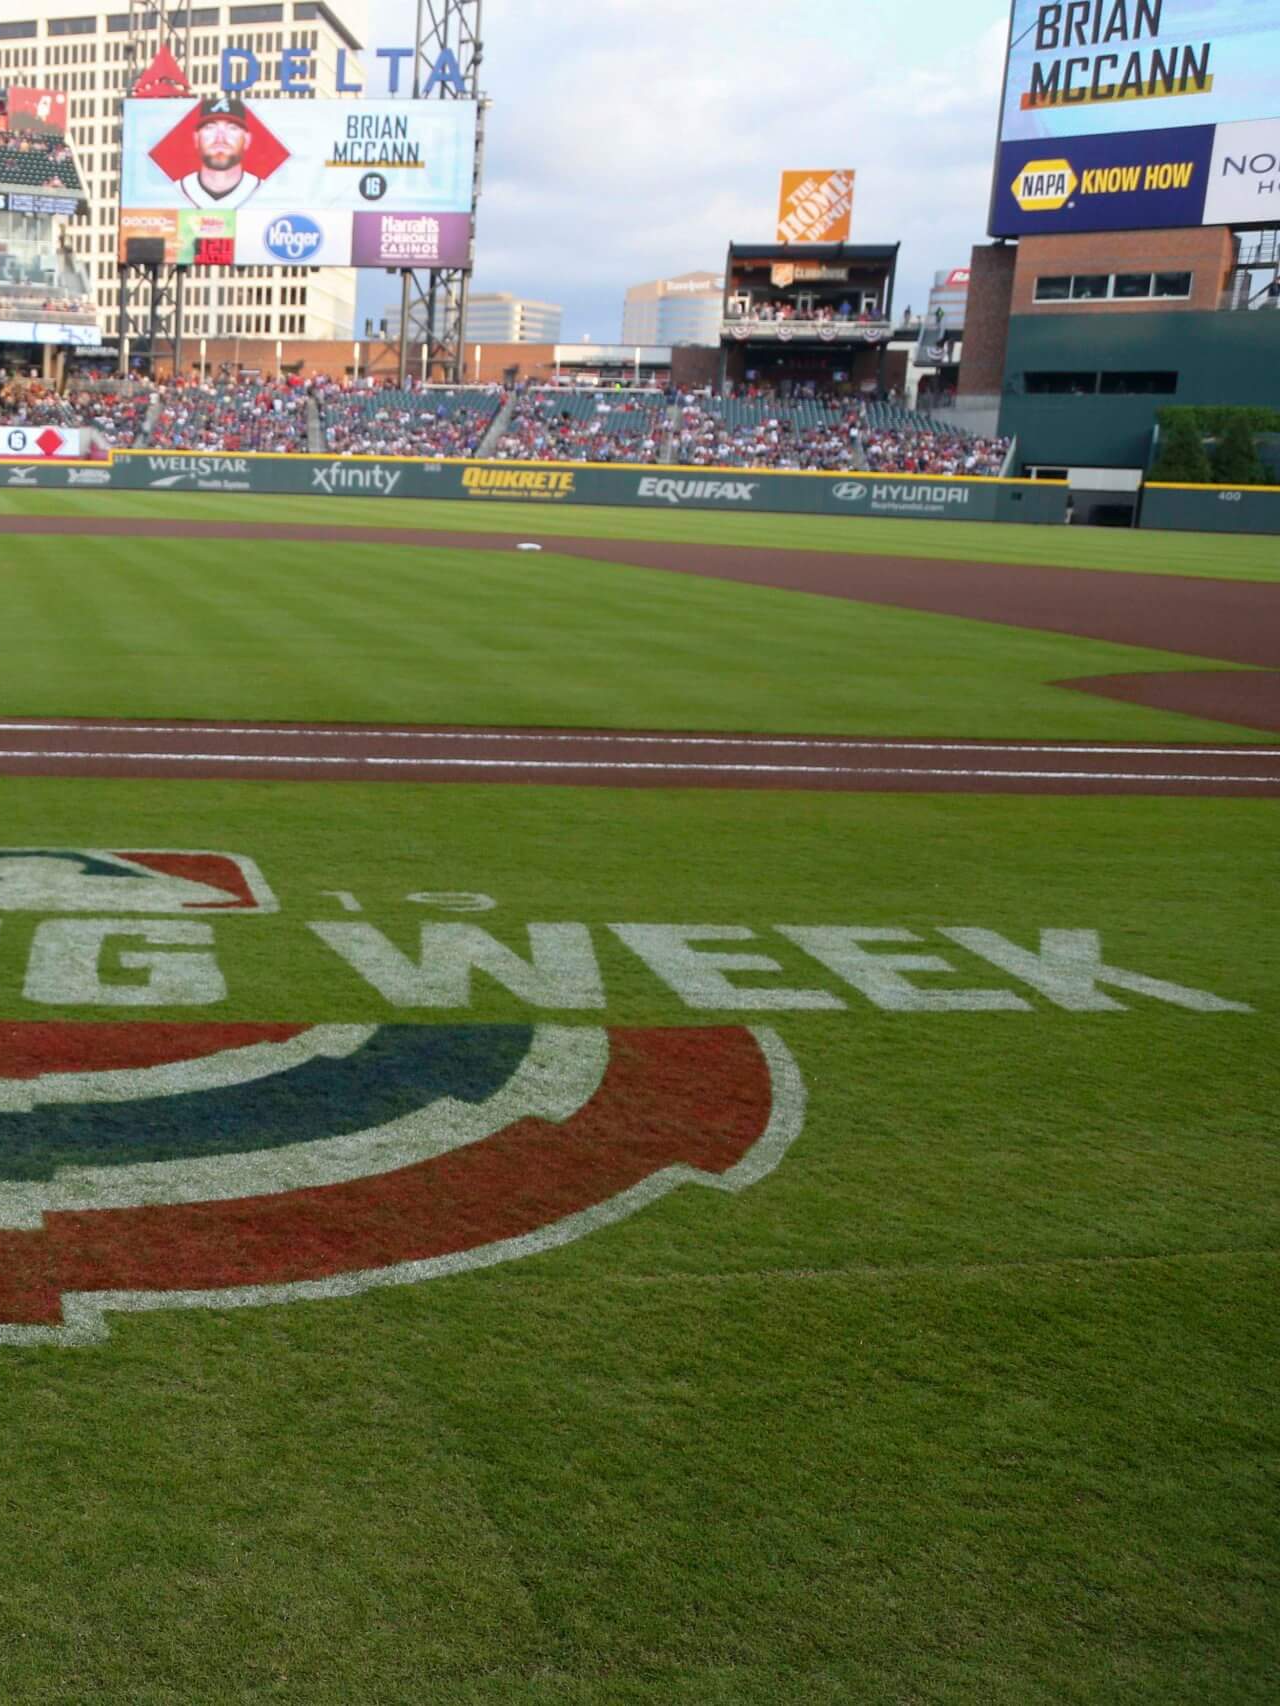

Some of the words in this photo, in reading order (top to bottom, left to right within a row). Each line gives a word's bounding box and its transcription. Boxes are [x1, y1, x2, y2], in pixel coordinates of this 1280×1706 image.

[1036, 0, 1162, 50] BRIAN
[221, 47, 466, 94] DELTA
[1029, 43, 1210, 106] MCCANN
[346, 115, 408, 139] BRIAN
[333, 142, 420, 165] MCCANN
[1223, 154, 1280, 176] NO
[363, 177, 381, 196] 16
[1022, 173, 1065, 197] NAPA
[1081, 166, 1141, 194] KNOW
[1144, 162, 1194, 190] HOW
[1258, 181, 1280, 194] H
[787, 178, 818, 206] THE
[778, 171, 853, 241] HOME
[269, 219, 320, 258] Kroger
[380, 243, 438, 254] CASINOS
[148, 456, 249, 476] WELLSTAR
[311, 461, 401, 495] xfinity
[462, 467, 575, 491] QUIKRETE
[637, 477, 754, 502] EQUIFAX
[872, 484, 969, 503] HYUNDAI
[1218, 491, 1242, 501] 400
[307, 920, 1256, 1014] WEEK
